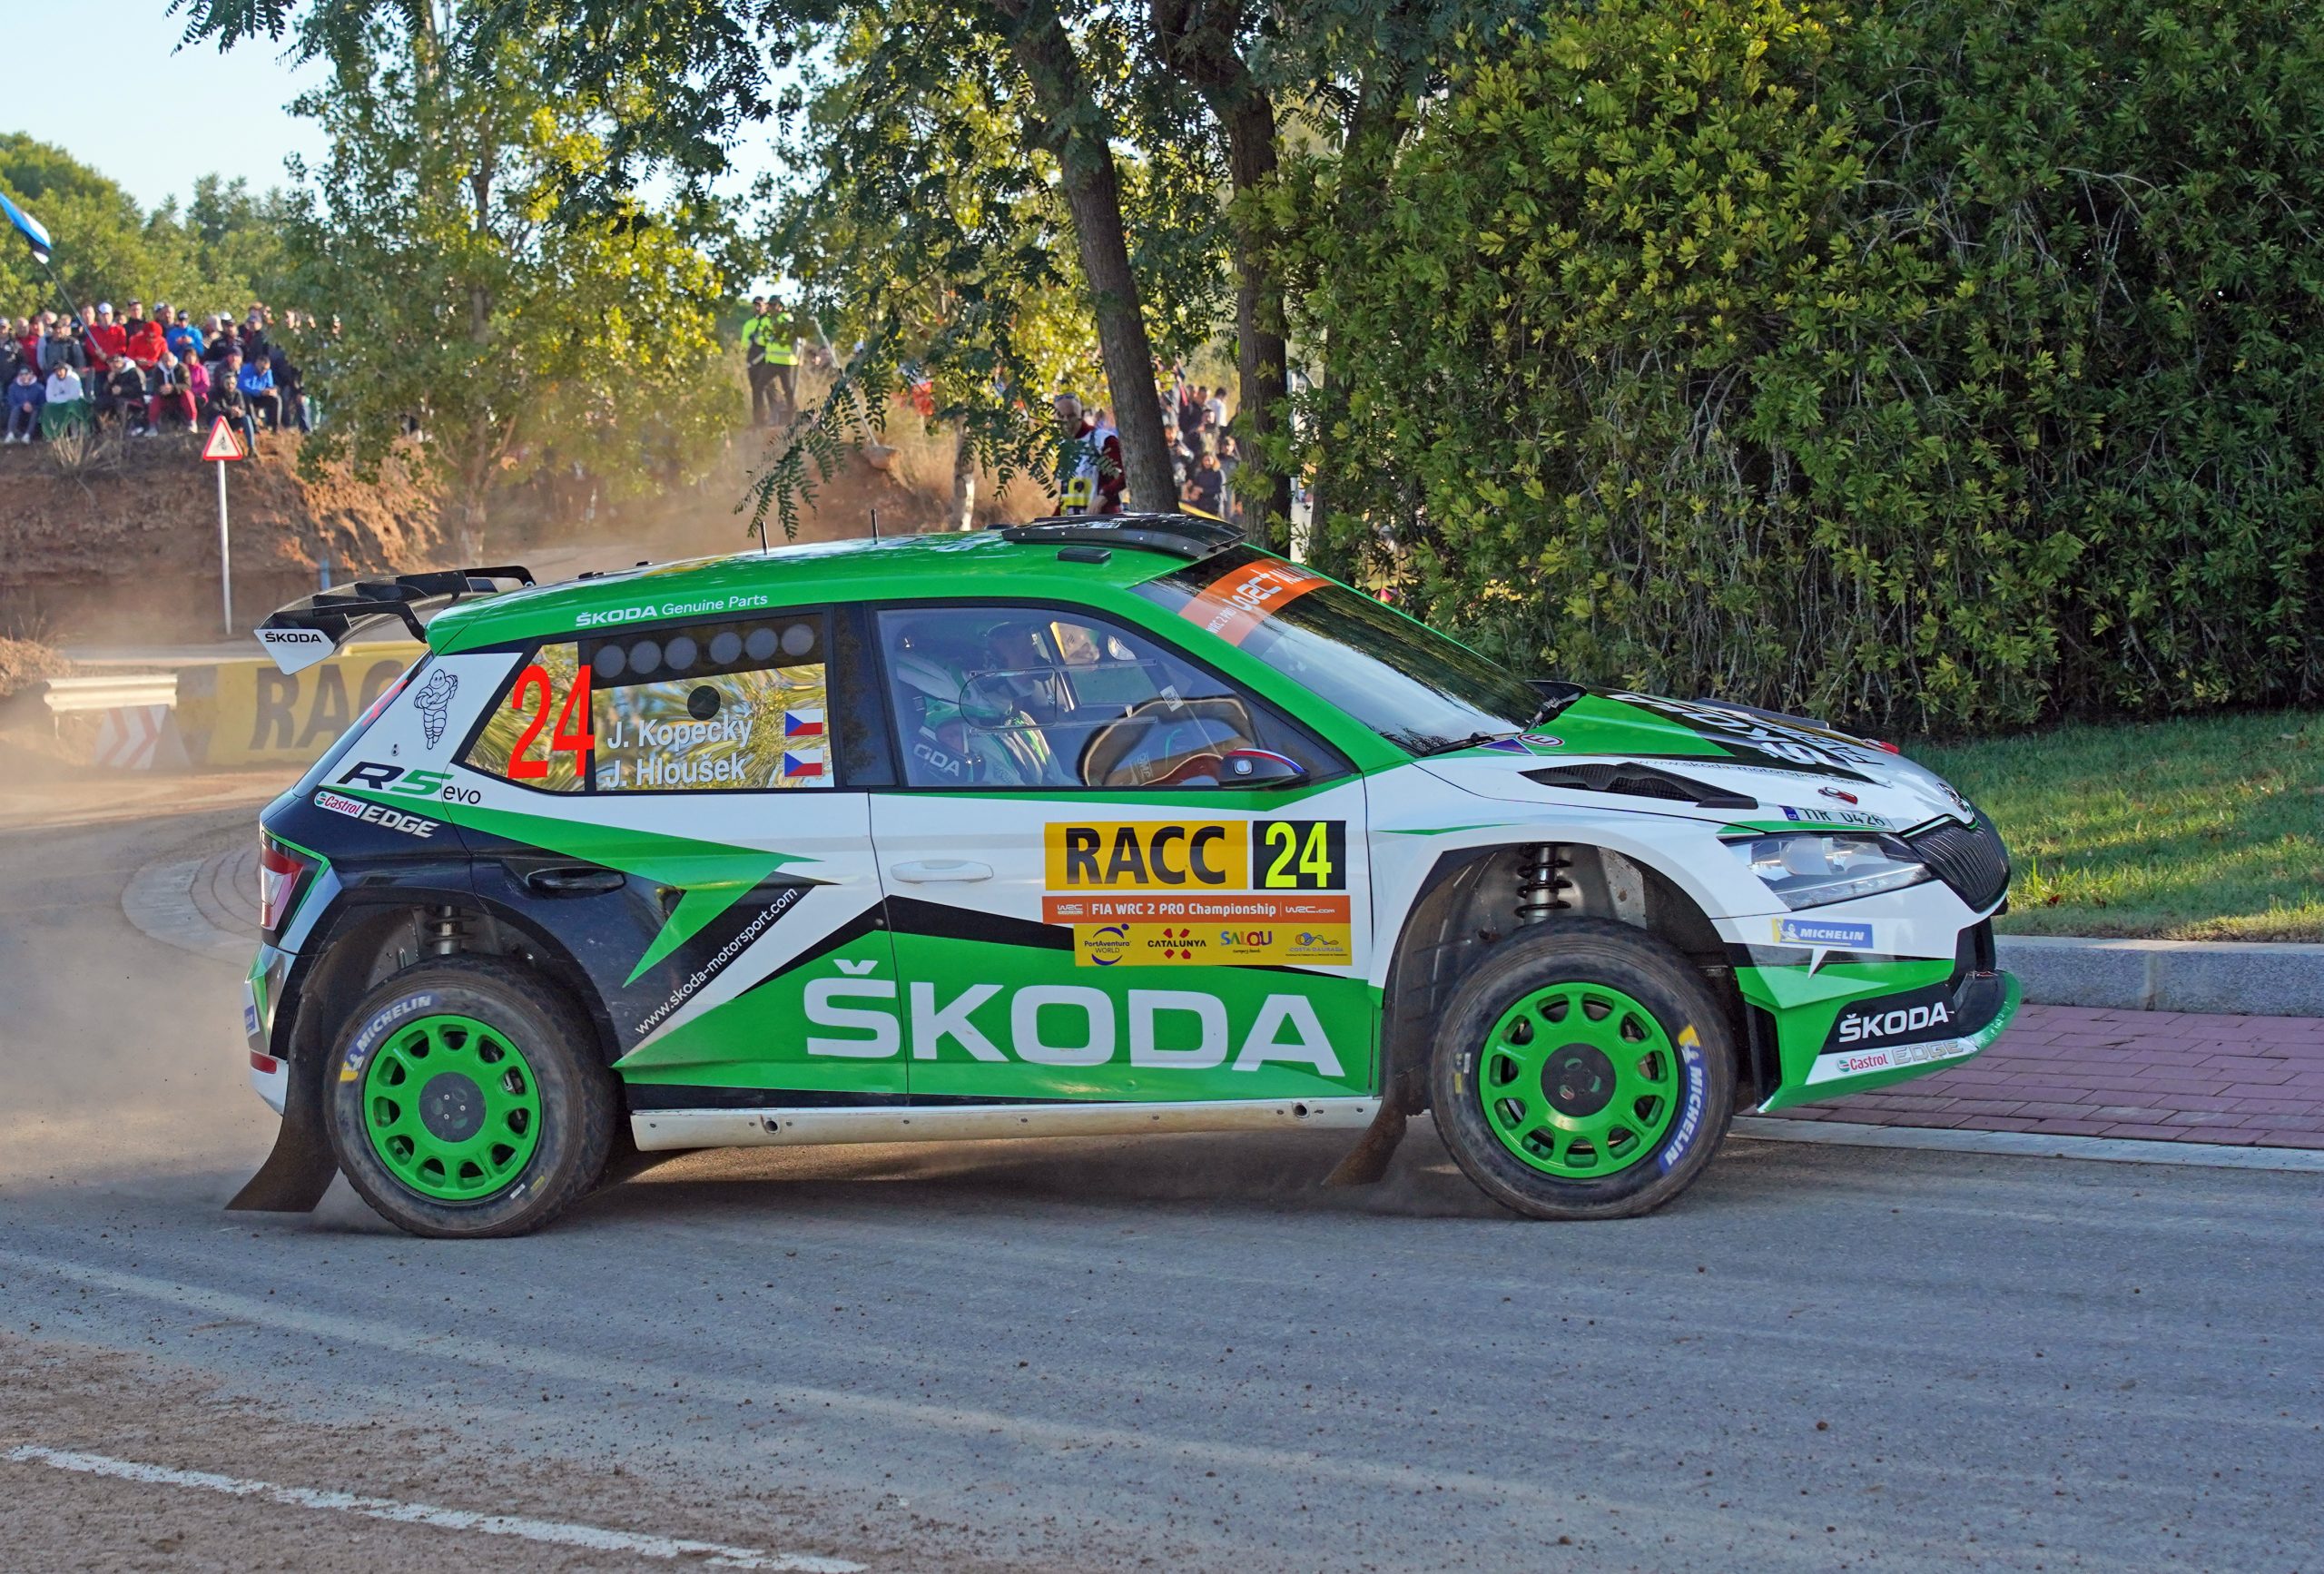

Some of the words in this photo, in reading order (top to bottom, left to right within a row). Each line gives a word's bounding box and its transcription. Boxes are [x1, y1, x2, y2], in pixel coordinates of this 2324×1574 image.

[576, 605, 658, 627] ŠKODA
[662, 599, 724, 615] Genuine
[728, 595, 768, 608] Parts
[264, 631, 322, 644] ŠKODA
[507, 665, 595, 780] 24
[606, 721, 629, 749] J.
[638, 712, 753, 752] Kopecký
[336, 761, 454, 796] R5
[443, 785, 481, 805] evo
[606, 760, 627, 788] J.
[636, 753, 747, 786] Hloušek
[324, 794, 362, 815] Castrol
[359, 805, 439, 839] EDGE
[1066, 826, 1226, 885] RACC
[1265, 821, 1333, 888] 24
[1092, 903, 1113, 915] FIA
[1116, 903, 1144, 915] WRC
[1147, 903, 1155, 915] 2
[1159, 903, 1184, 915] PRO
[1188, 902, 1277, 917] Championship
[1147, 939, 1206, 948] CATALUNYA
[1220, 930, 1273, 947] SALOU
[1800, 928, 1866, 941] MICHELIN
[635, 887, 798, 1035] www.skoda-motorsport.com
[357, 995, 433, 1051] MICHELIN
[803, 959, 1345, 1077] ŠKODA
[1838, 1001, 1950, 1043] ŠKODA
[1849, 1054, 1889, 1070] Castrol
[1892, 1039, 1965, 1067] EDGE
[1664, 1067, 1704, 1166] MICHELIN
